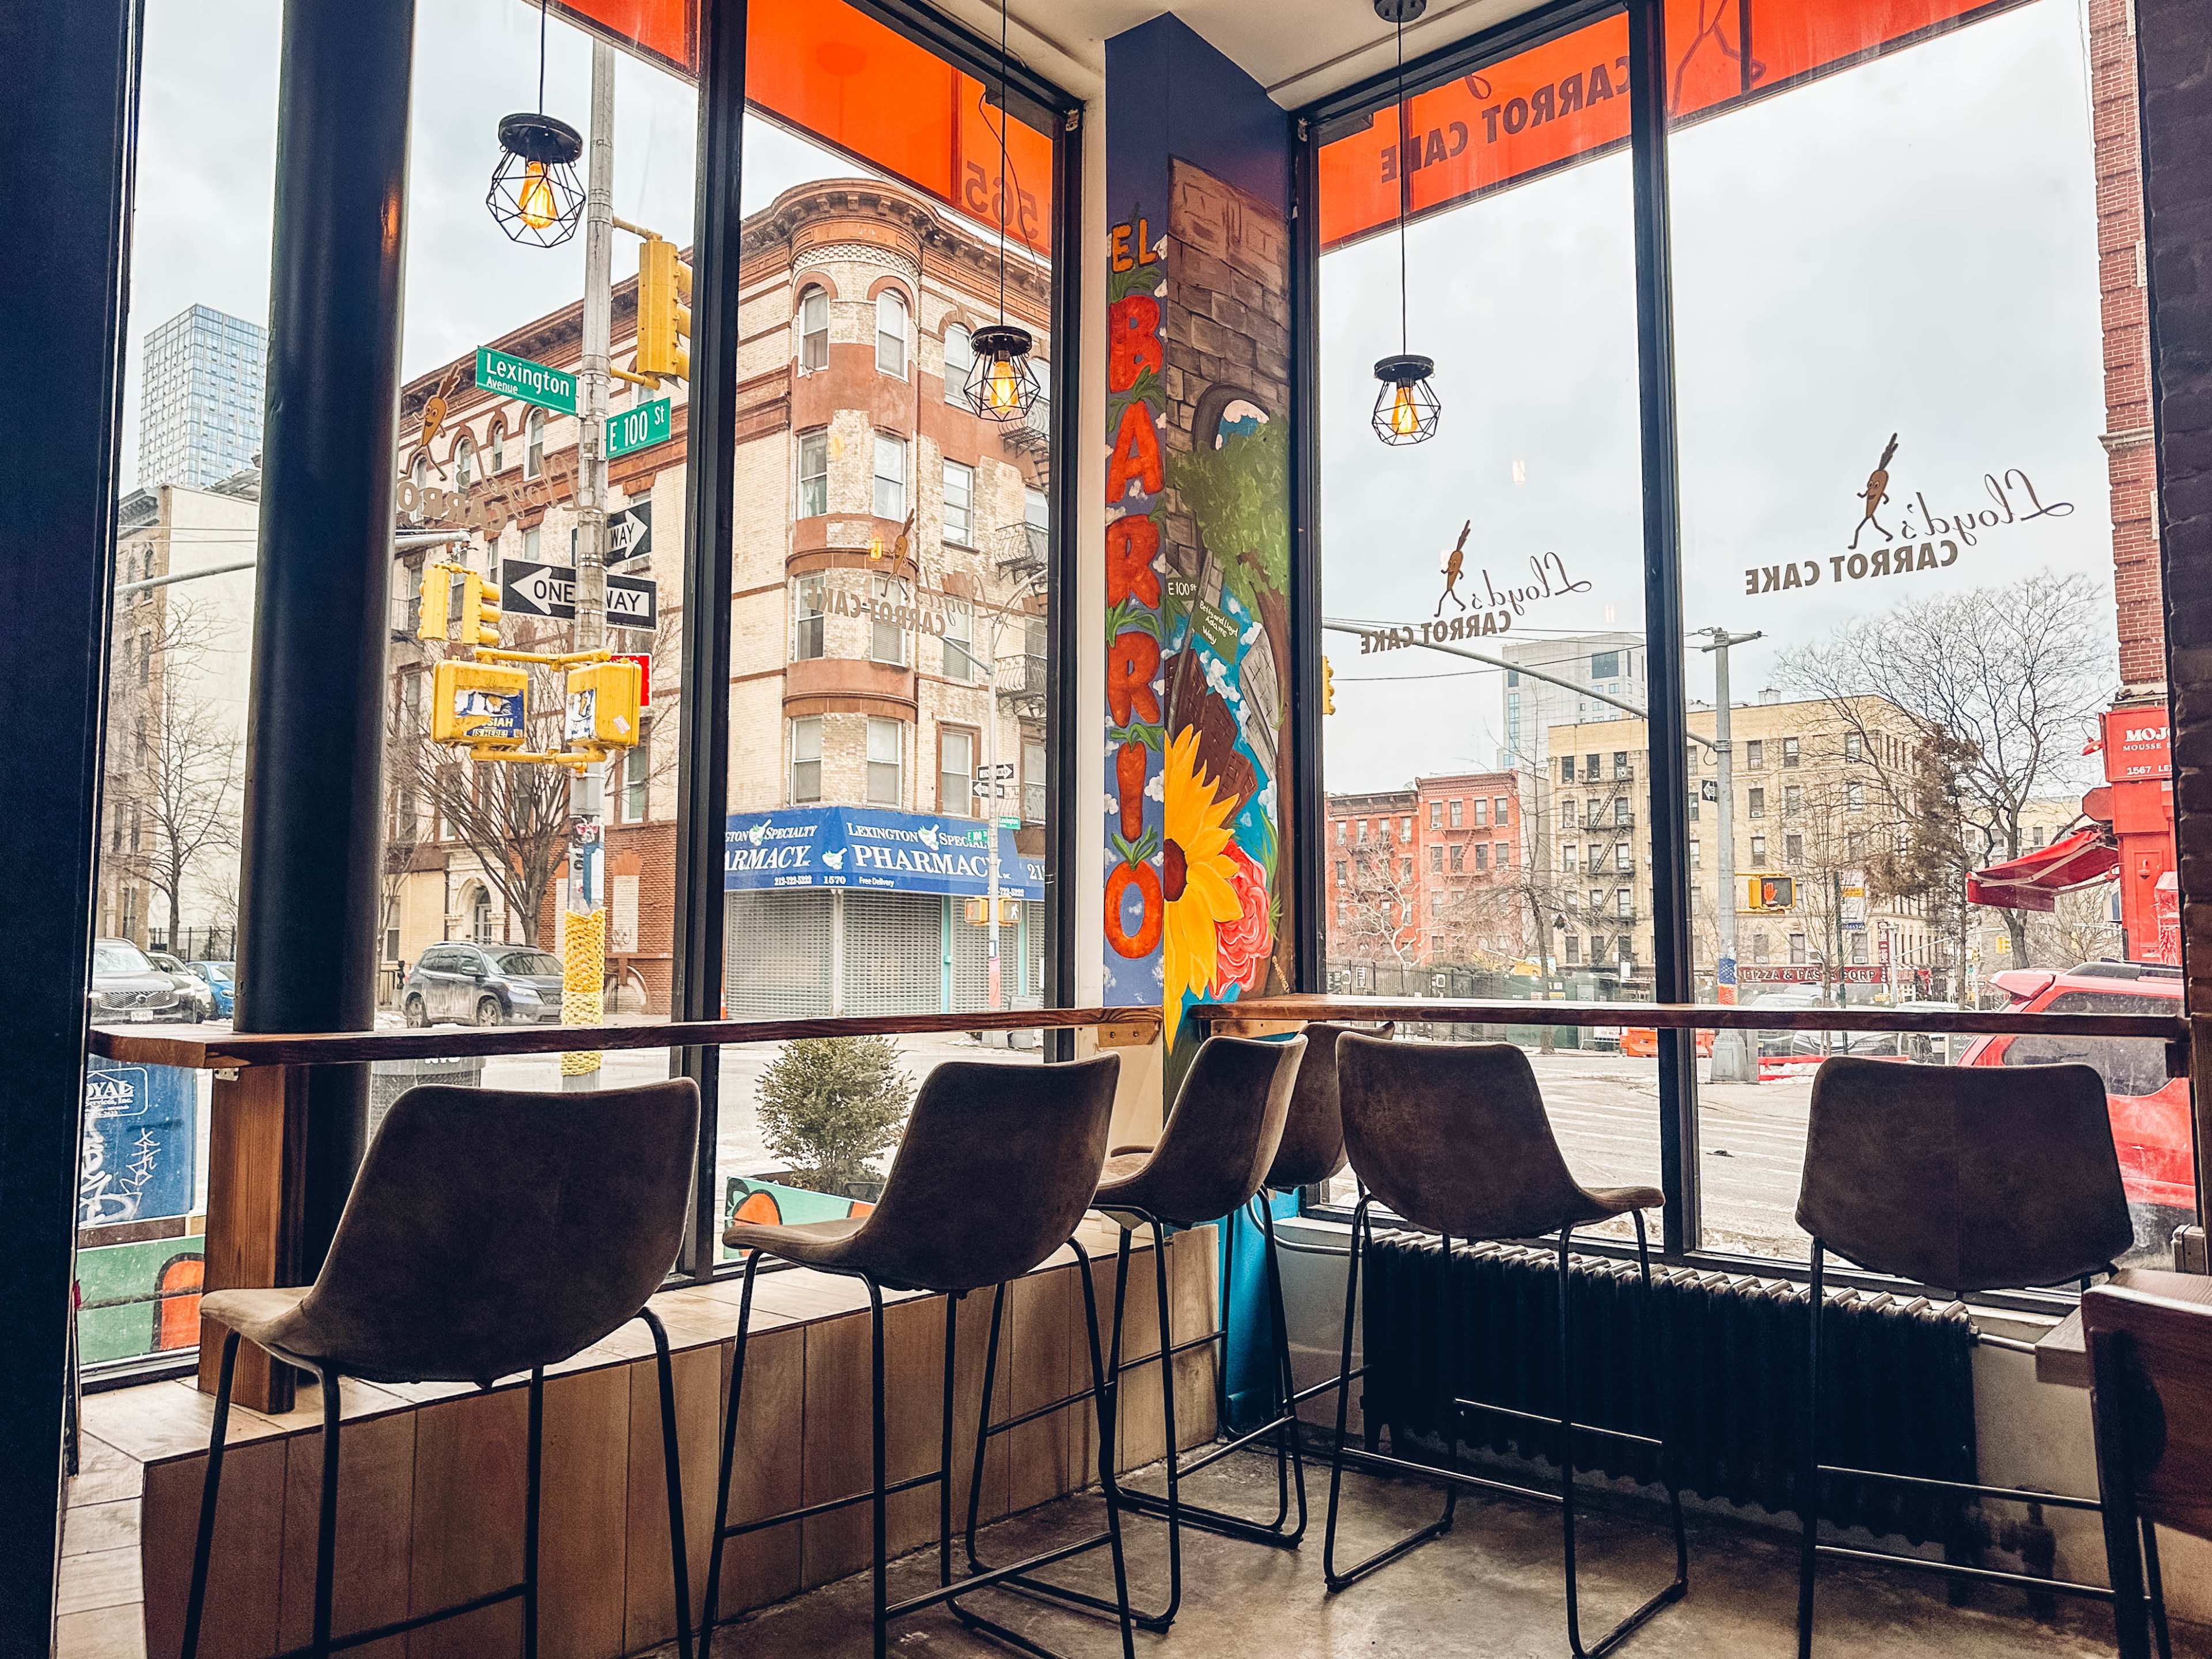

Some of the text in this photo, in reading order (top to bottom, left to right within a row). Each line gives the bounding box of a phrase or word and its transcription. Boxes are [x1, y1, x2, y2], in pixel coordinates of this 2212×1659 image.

[1111, 217, 1159, 275] EL
[487, 353, 570, 397] Lexington
[486, 376, 518, 395] Avenue
[609, 405, 665, 453] E 100 St
[611, 522, 635, 548] WAY
[534, 579, 575, 604] ONE
[1168, 582, 1175, 596] E
[1175, 582, 1190, 596] 100
[1104, 294, 1165, 959] BARRIO
[1202, 626, 1217, 646] Way
[2123, 743, 2162, 752] MOUSSE
[2127, 765, 2152, 775] 1567
[764, 825, 818, 840] SPECIALTY
[846, 822, 920, 843] LEXINGTON
[823, 875, 847, 885] 1570
[1027, 863, 1046, 881] 21
[858, 876, 895, 888] Free Delivery
[1743, 969, 1779, 980] PIZZA
[1783, 969, 1793, 980] &
[1797, 969, 1838, 980] PASA
